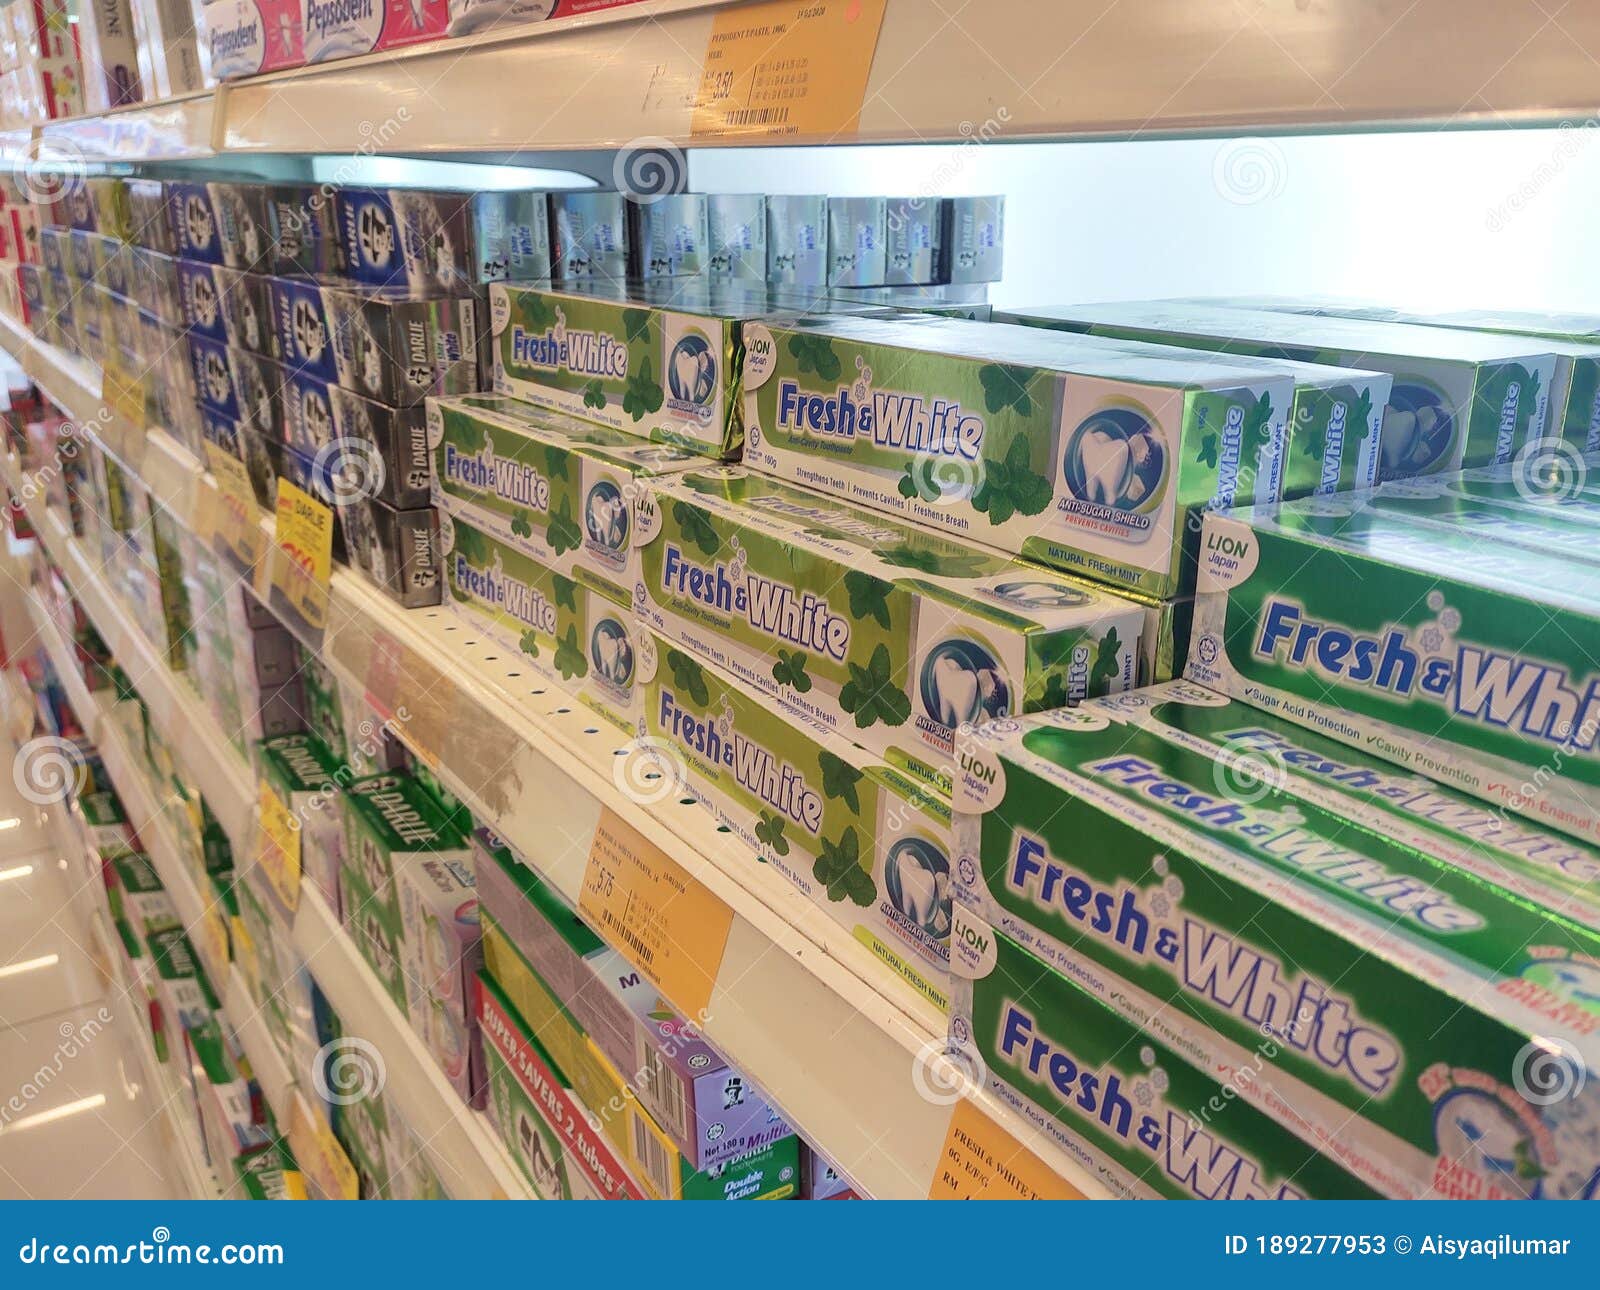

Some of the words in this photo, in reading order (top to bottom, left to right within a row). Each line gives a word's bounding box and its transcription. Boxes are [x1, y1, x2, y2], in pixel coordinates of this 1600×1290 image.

[713, 71, 733, 99] 3.50
[409, 320, 426, 362] DARLIE
[446, 333, 460, 361] White
[411, 425, 428, 467] DARLIE
[1371, 417, 1380, 444] MINT
[1367, 448, 1377, 482] FRESH
[797, 467, 828, 484] Strengthens
[830, 477, 845, 489] Teeth
[853, 484, 878, 500] Prevents
[880, 492, 904, 508] Cavities
[914, 503, 944, 521] Freshens
[946, 513, 969, 530] Breath
[1059, 499, 1111, 522] ANTI-SUGAR
[1113, 510, 1148, 530] SHIELD
[413, 528, 431, 566] DARLIE
[1207, 532, 1248, 559] LION
[1208, 552, 1238, 570] Japan
[1048, 547, 1086, 567] NATURAL
[1088, 556, 1117, 576] FRESH
[1117, 566, 1141, 584] MINT
[681, 631, 710, 657] Strengthens
[711, 648, 725, 664] Teeth
[732, 660, 755, 681] Prevents
[756, 674, 778, 694] Cavities
[787, 691, 816, 716] Freshens
[816, 707, 837, 727] Breath
[1123, 655, 1132, 681] MINT
[916, 715, 952, 742] ANTI-SUG
[961, 753, 996, 784] LION
[1253, 688, 1280, 709] Sugar
[1282, 699, 1304, 719] Acid
[1306, 708, 1360, 740] Protection
[1376, 737, 1411, 761] Cavity
[1414, 750, 1480, 786] Prevention
[1540, 800, 1591, 830] Enamel
[962, 773, 989, 795] Japan
[370, 792, 440, 845] DARLIE
[767, 851, 792, 878] Freshens
[597, 867, 615, 897] 5.75
[881, 902, 922, 944] ANTI-SUGAR
[924, 934, 950, 961] SHIELD
[955, 919, 988, 954] LION
[955, 938, 980, 964] Japan
[619, 973, 640, 989] M
[872, 942, 903, 972] NATURAL
[904, 967, 928, 993] FRESH
[928, 987, 947, 1008] MINT
[1009, 921, 1034, 943] Sugar
[1036, 938, 1055, 960] Acid
[1057, 953, 1105, 992] Protection
[1119, 996, 1150, 1025] Cavity
[1152, 1018, 1211, 1064] Prevention
[483, 1002, 518, 1059] SUPER
[518, 1049, 563, 1123] SAVERS
[565, 1116, 576, 1139] 2
[577, 1133, 615, 1193] tubes
[747, 1123, 792, 1149] Multic
[999, 1084, 1024, 1109] Sugar
[1025, 1107, 1045, 1127] Acid
[1046, 1122, 1093, 1167] Protection
[705, 1145, 720, 1158] Net
[954, 1128, 985, 1160] FRESH
[985, 1155, 992, 1167] &
[996, 1162, 1029, 1197] WHITE
[724, 1170, 764, 1193] Double
[726, 1182, 760, 1200] Action
[943, 1171, 959, 1190] RM
